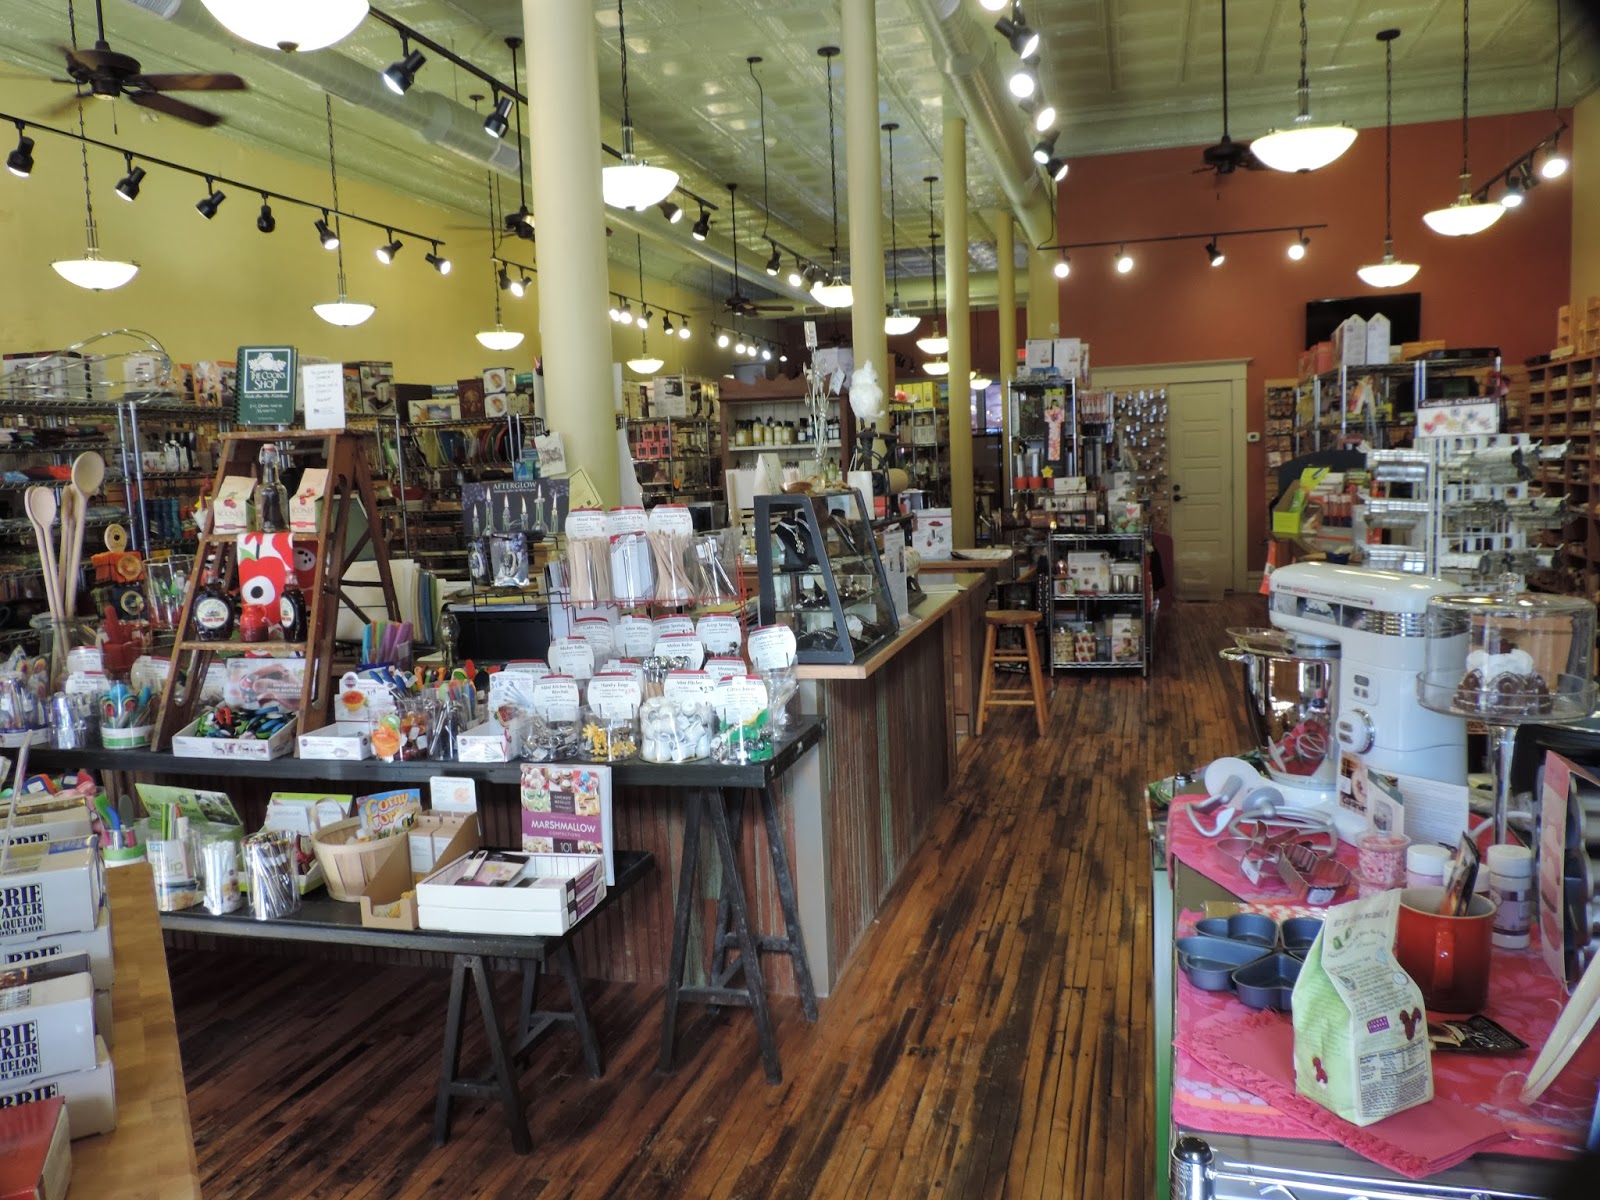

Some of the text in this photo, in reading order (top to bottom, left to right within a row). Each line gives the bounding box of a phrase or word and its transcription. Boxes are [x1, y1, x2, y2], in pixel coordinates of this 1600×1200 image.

[254, 380, 278, 391] SHOP
[493, 481, 537, 490] AFTERGLOW
[365, 793, 408, 814] Corny
[1342, 796, 1367, 812] Cuisinar
[531, 820, 596, 833] MARSHMALLOW
[559, 843, 572, 853] 101
[0, 915, 43, 931] QUELON
